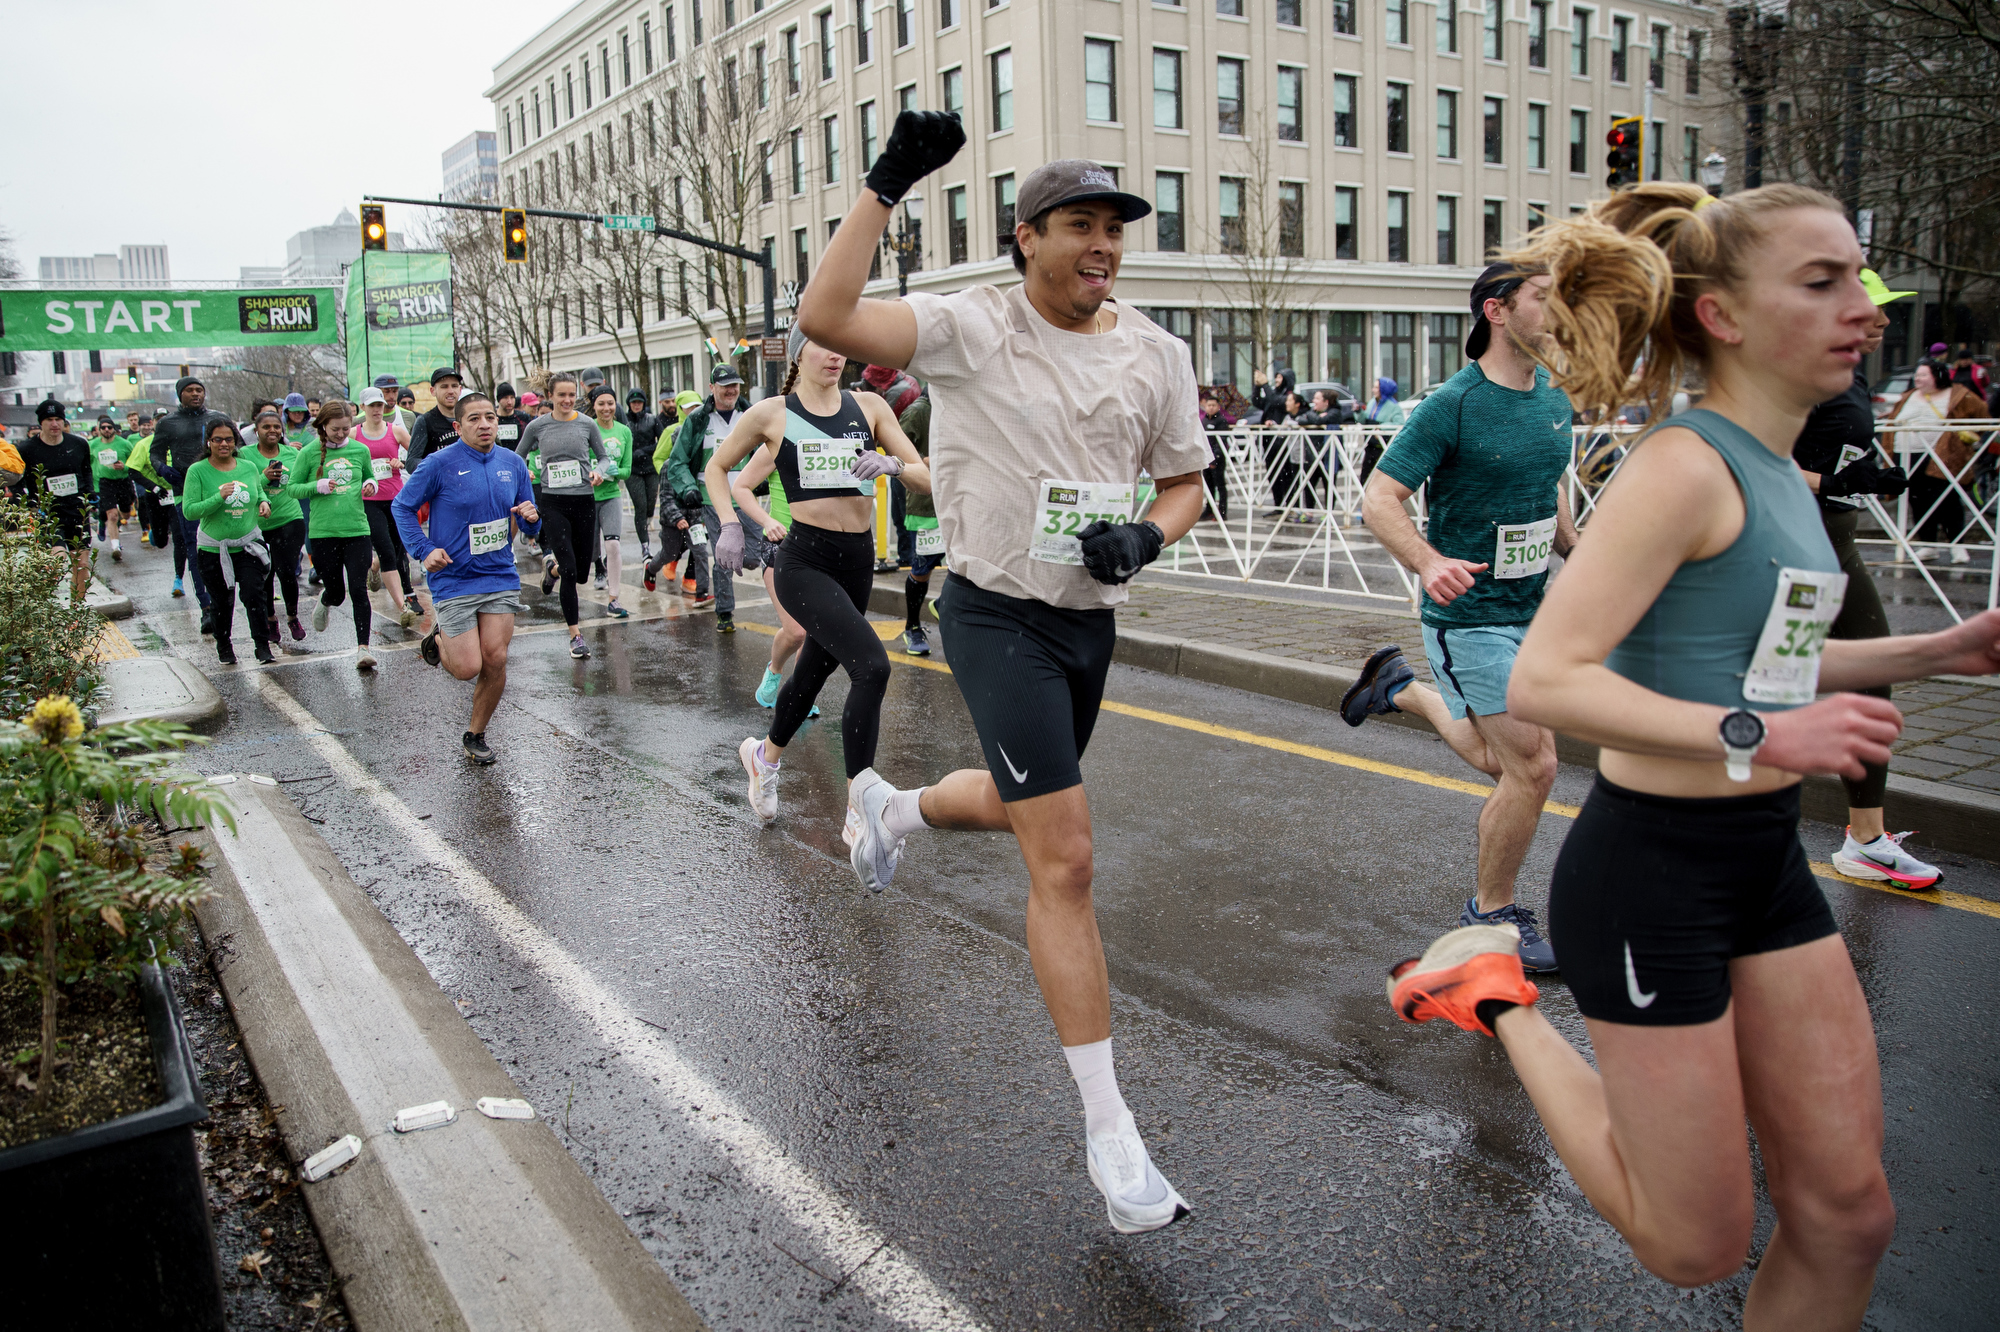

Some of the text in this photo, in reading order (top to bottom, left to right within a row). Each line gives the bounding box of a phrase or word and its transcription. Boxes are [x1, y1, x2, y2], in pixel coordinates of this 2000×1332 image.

[616, 218, 626, 228] SW
[645, 219, 653, 230] ST
[371, 283, 443, 304] SHAMROCK
[245, 296, 310, 309] SHAMROCK
[400, 294, 448, 319] RUN
[45, 300, 202, 334] START
[269, 306, 312, 326] RUN
[403, 313, 449, 325] PORTLAND
[842, 431, 870, 440] NETC
[804, 456, 858, 471] 32910
[552, 468, 577, 479] 31316
[51, 481, 75, 491] 31376
[1059, 493, 1076, 502] RUN
[918, 535, 944, 546] 3107
